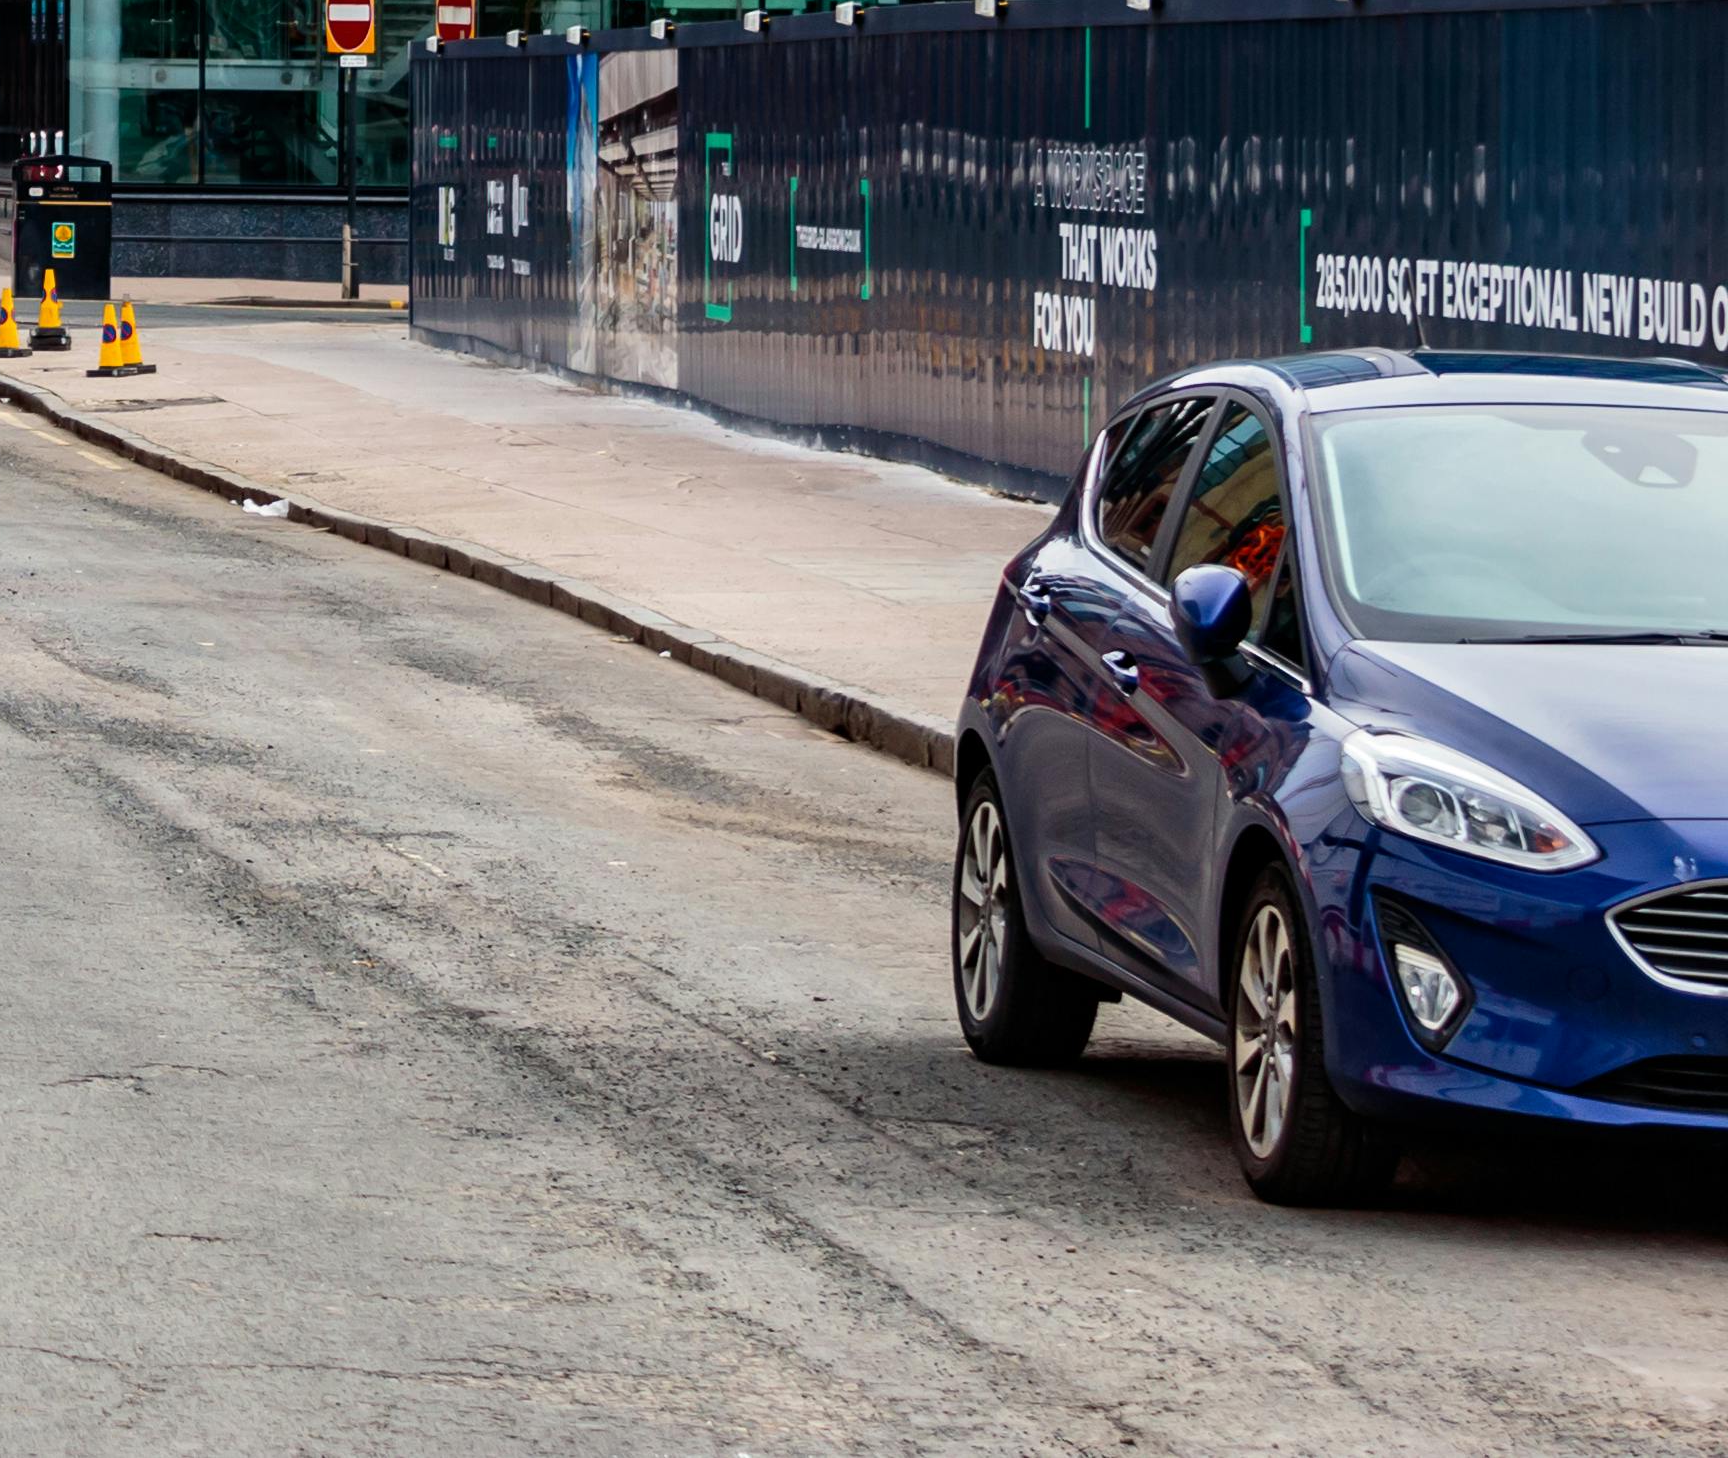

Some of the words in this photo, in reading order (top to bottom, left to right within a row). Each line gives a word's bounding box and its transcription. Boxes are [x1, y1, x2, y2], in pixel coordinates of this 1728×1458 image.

[1034, 147, 1046, 207] A
[1047, 149, 1146, 215] WORKSPACE
[709, 193, 743, 263] GRID
[1059, 222, 1098, 284] THAT
[1099, 226, 1158, 291] WORKS
[1034, 292, 1063, 352] FOR
[1063, 295, 1095, 357] YOU
[1315, 253, 1384, 318] 285,000
[1387, 258, 1413, 326] SQ
[1415, 259, 1440, 317] FT
[1442, 261, 1578, 332] EXCEPTIONAL
[1581, 271, 1635, 339] NEW
[1638, 277, 1708, 348] BUILD
